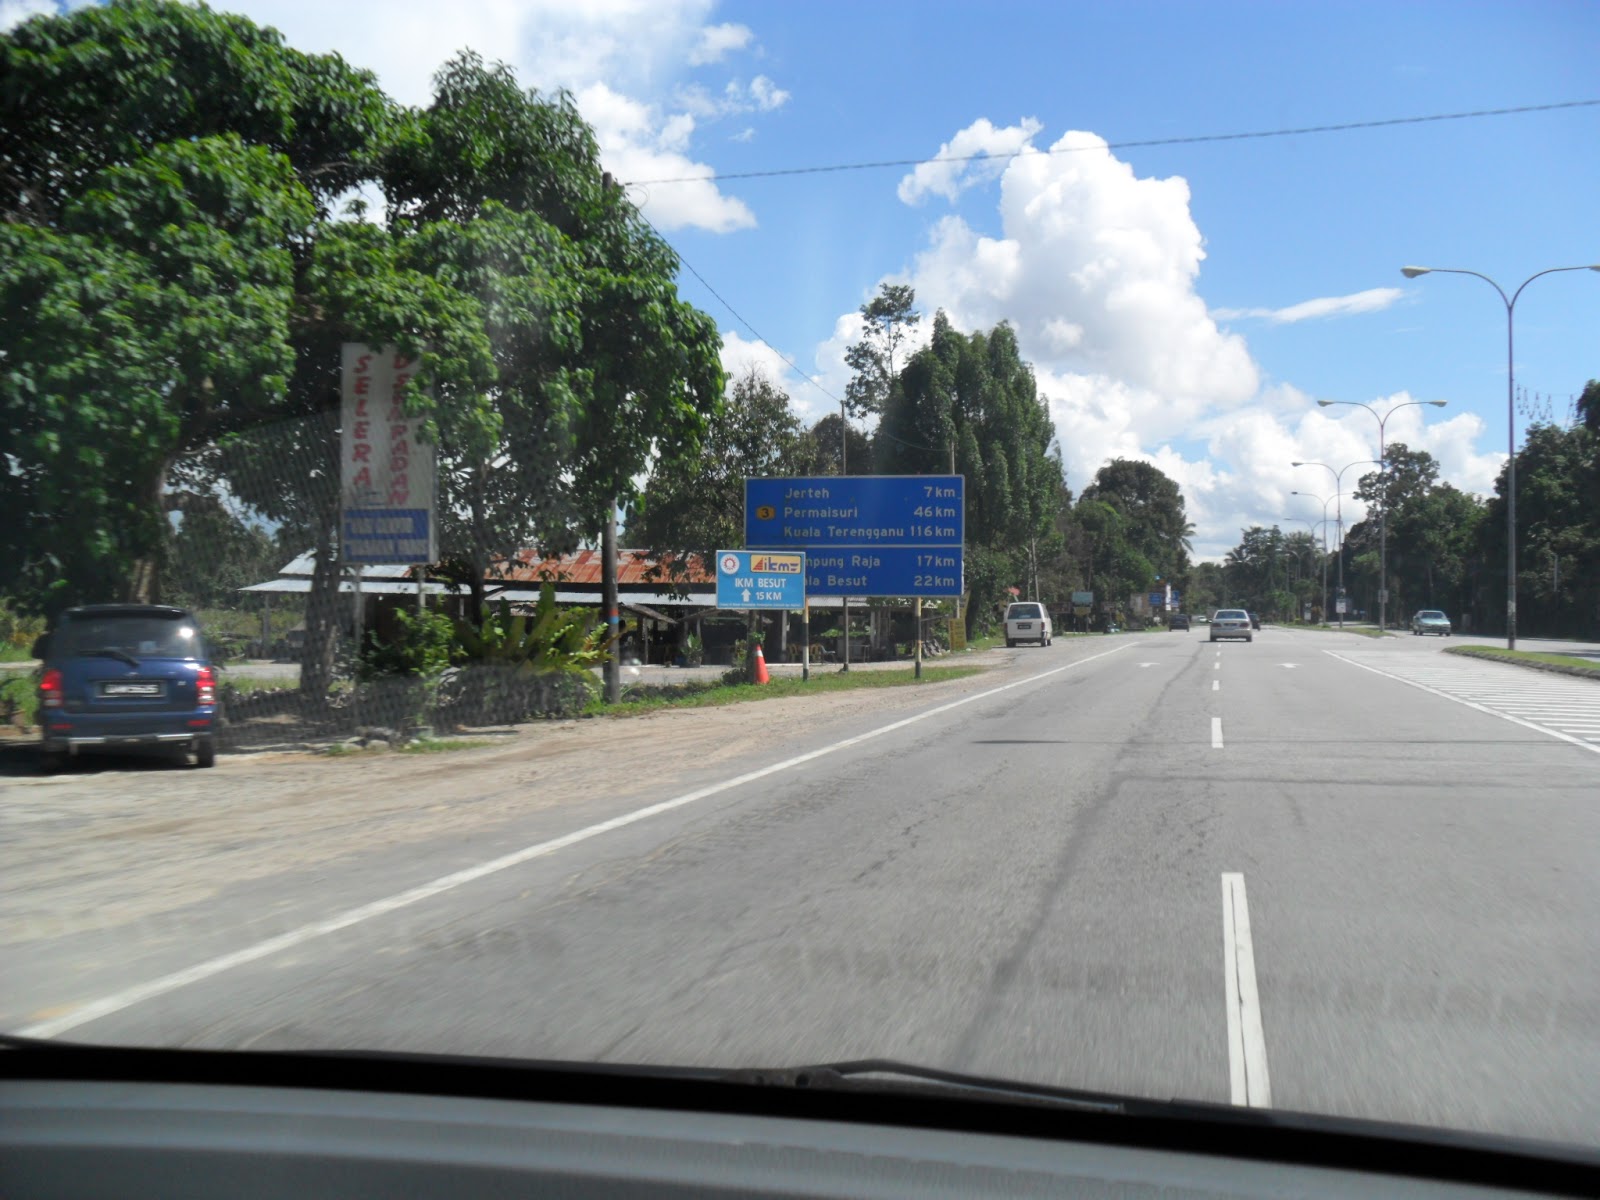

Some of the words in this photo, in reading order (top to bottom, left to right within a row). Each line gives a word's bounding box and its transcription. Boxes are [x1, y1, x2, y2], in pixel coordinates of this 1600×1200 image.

[353, 355, 373, 487] SELERA
[784, 486, 830, 499] Jerteh
[761, 507, 770, 519] 3
[784, 507, 858, 518] Permaisuri
[913, 506, 956, 517] 46km
[784, 526, 821, 537] Kuala
[828, 526, 904, 539] Terengganu
[910, 525, 956, 537] 116km
[852, 555, 881, 568] Raja
[734, 577, 754, 588] IKM
[758, 577, 787, 588] BESUT
[827, 574, 868, 586] Besut
[914, 575, 955, 587] 22km
